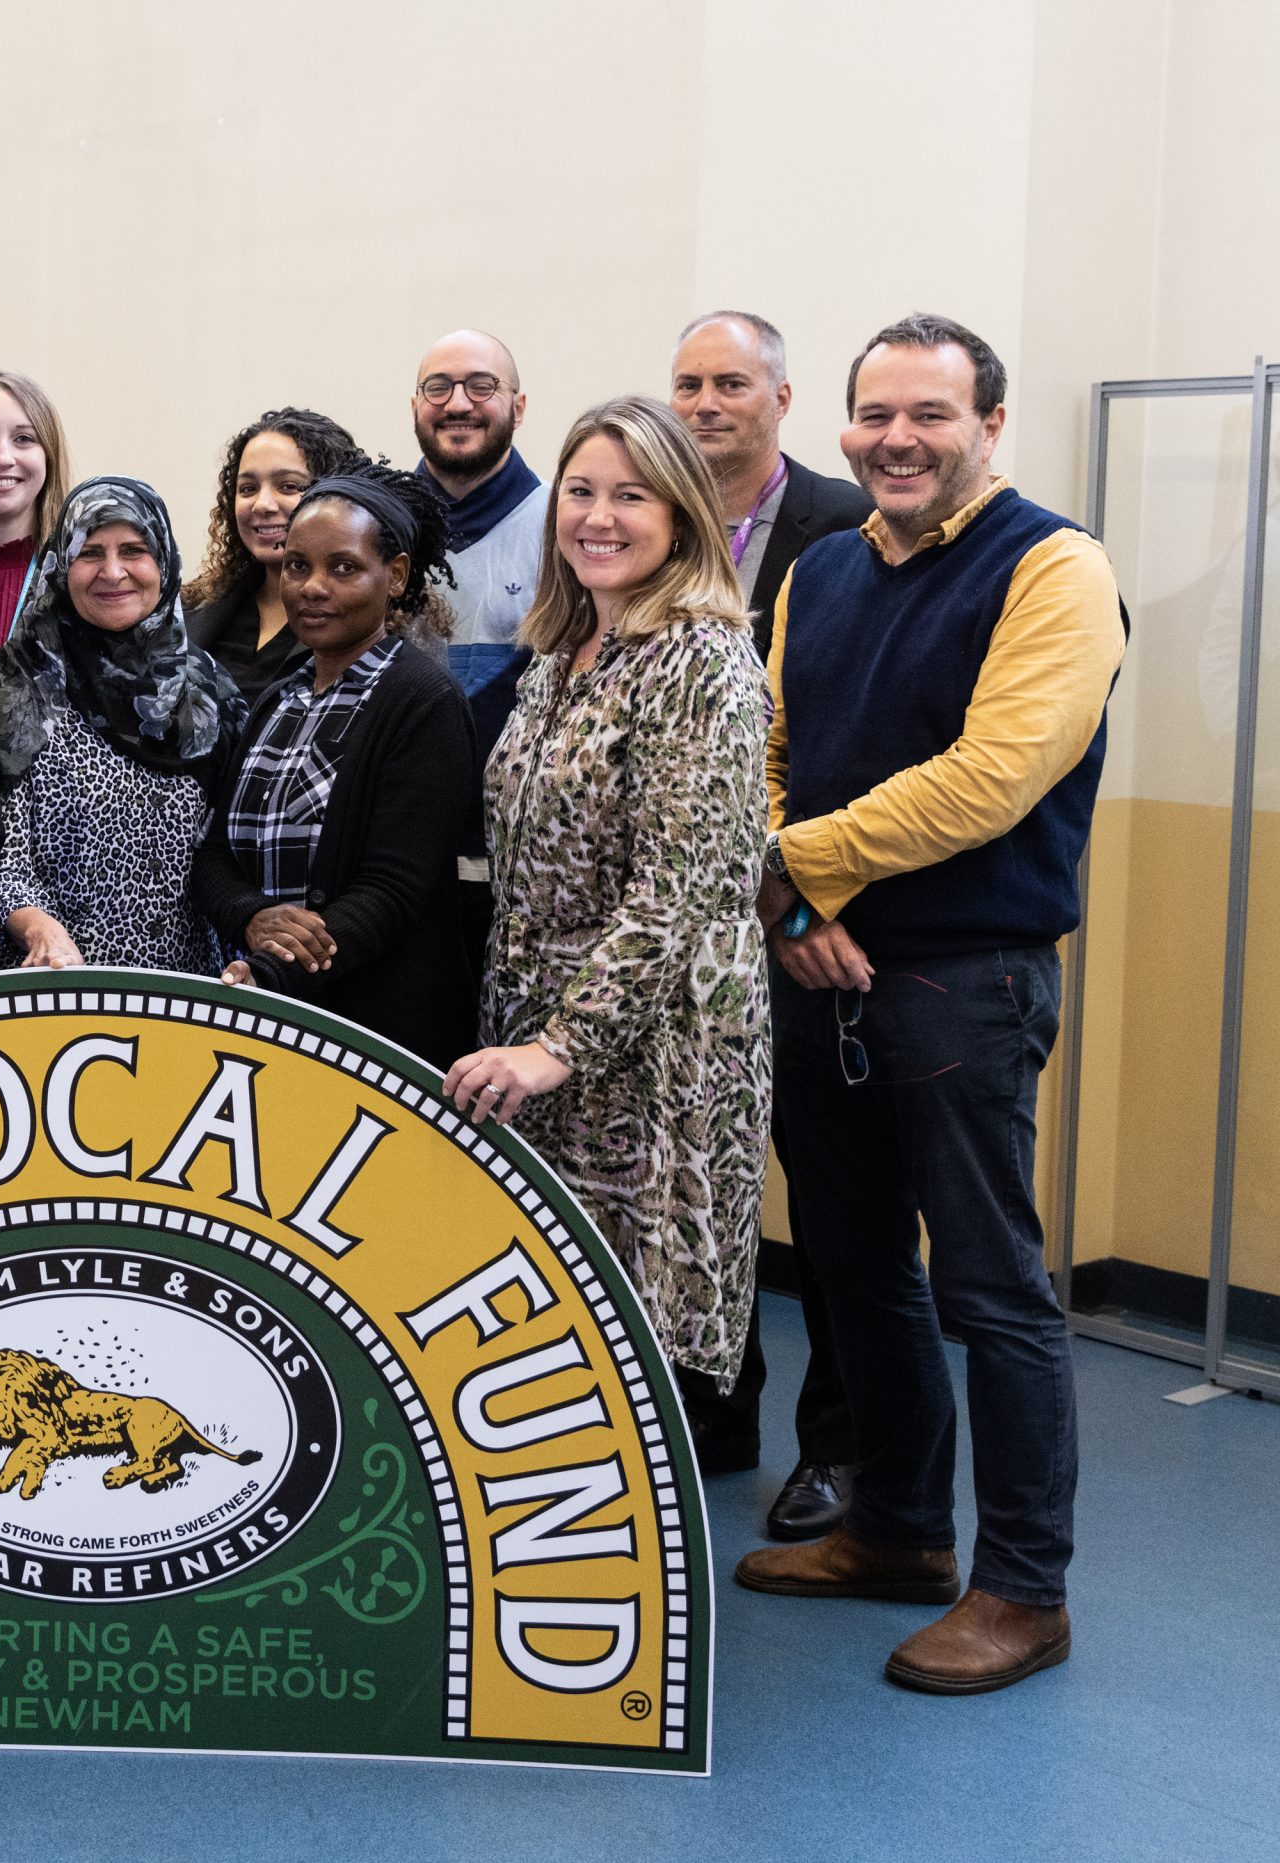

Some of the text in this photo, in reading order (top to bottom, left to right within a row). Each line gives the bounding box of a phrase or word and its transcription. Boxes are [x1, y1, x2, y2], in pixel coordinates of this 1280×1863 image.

[38, 1258, 142, 1287] LYLE
[164, 1271, 189, 1299] &
[208, 1288, 310, 1378] SONS
[396, 1237, 640, 1694] FUND
[0, 1522, 65, 1547] STRONG
[69, 1536, 115, 1549] CAME
[120, 1529, 172, 1547] FORTH
[174, 1479, 260, 1537] SWEETNESS
[72, 1506, 289, 1592] REFINERS
[22, 1658, 49, 1691] &
[68, 1659, 377, 1700] PROSPEROUS
[148, 1624, 179, 1656] A
[196, 1625, 324, 1667] SAFE,
